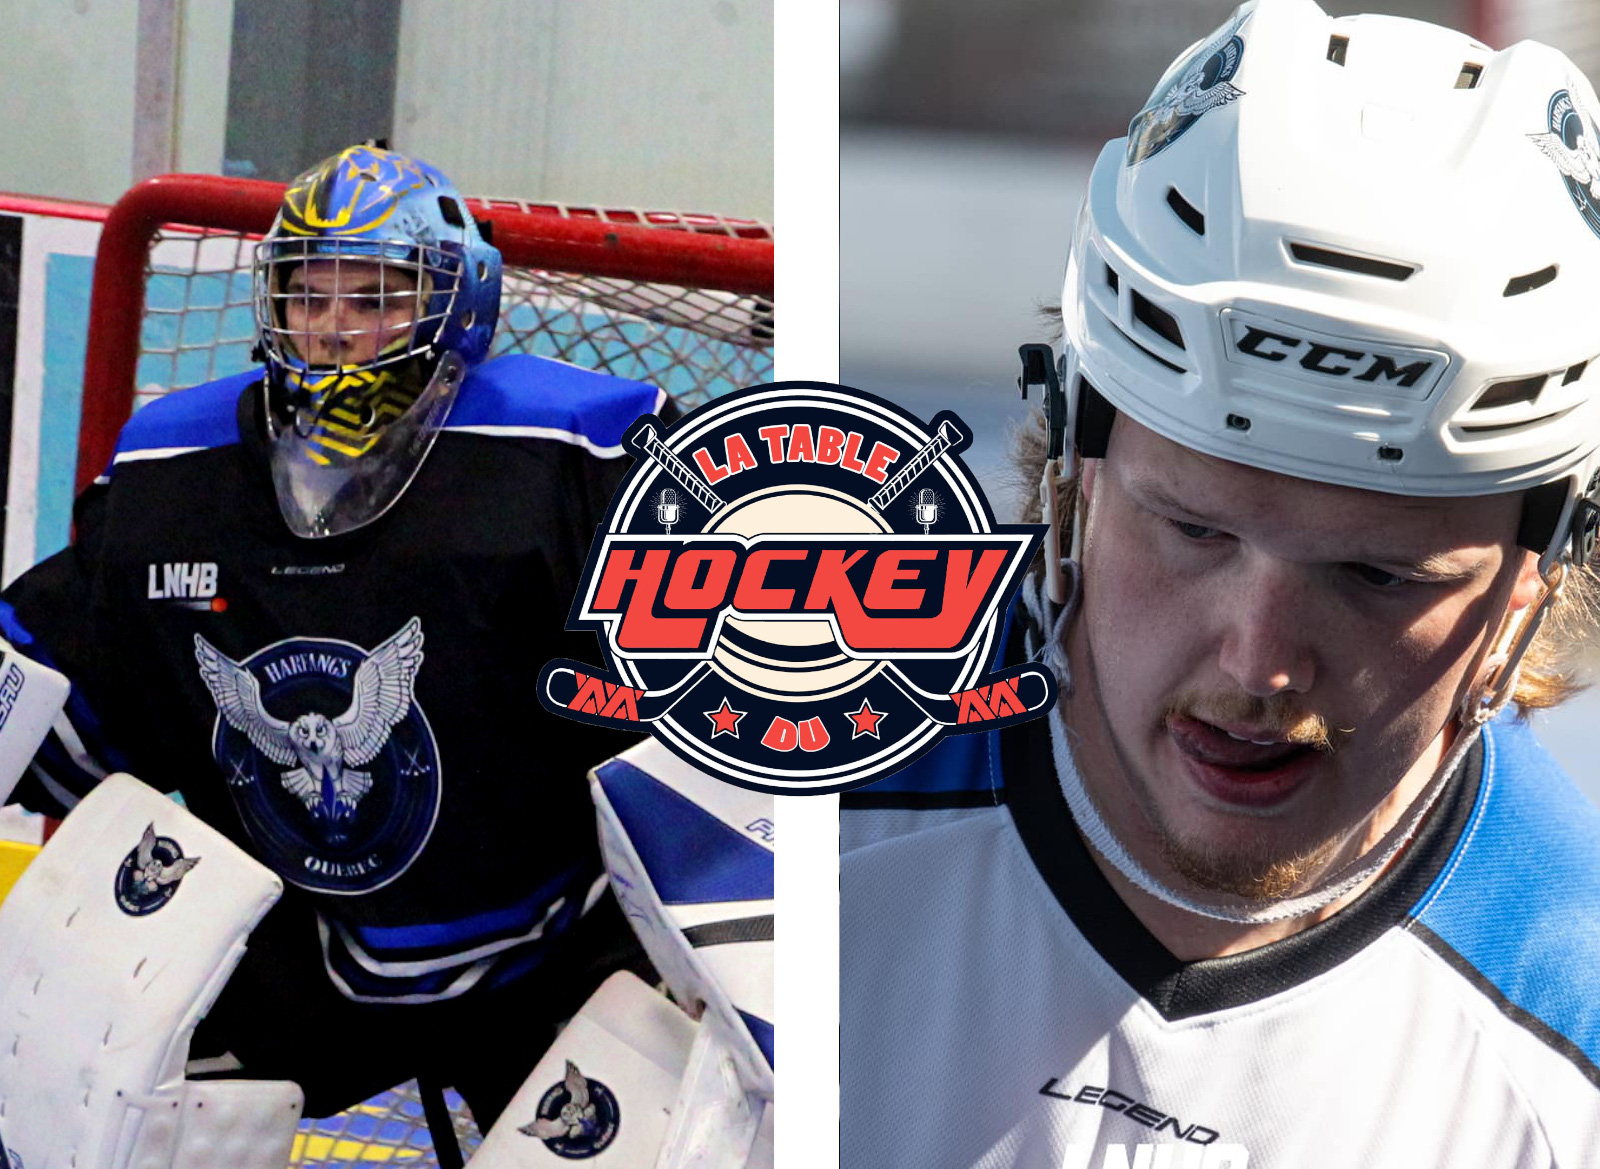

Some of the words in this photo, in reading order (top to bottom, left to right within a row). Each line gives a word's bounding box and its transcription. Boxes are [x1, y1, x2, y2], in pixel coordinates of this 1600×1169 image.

[1236, 325, 1433, 388] CCM
[148, 562, 218, 599] LNHB
[271, 563, 346, 575] LEGEND
[264, 653, 352, 683] HARFANGS
[1038, 1077, 1220, 1146] LEGEND
